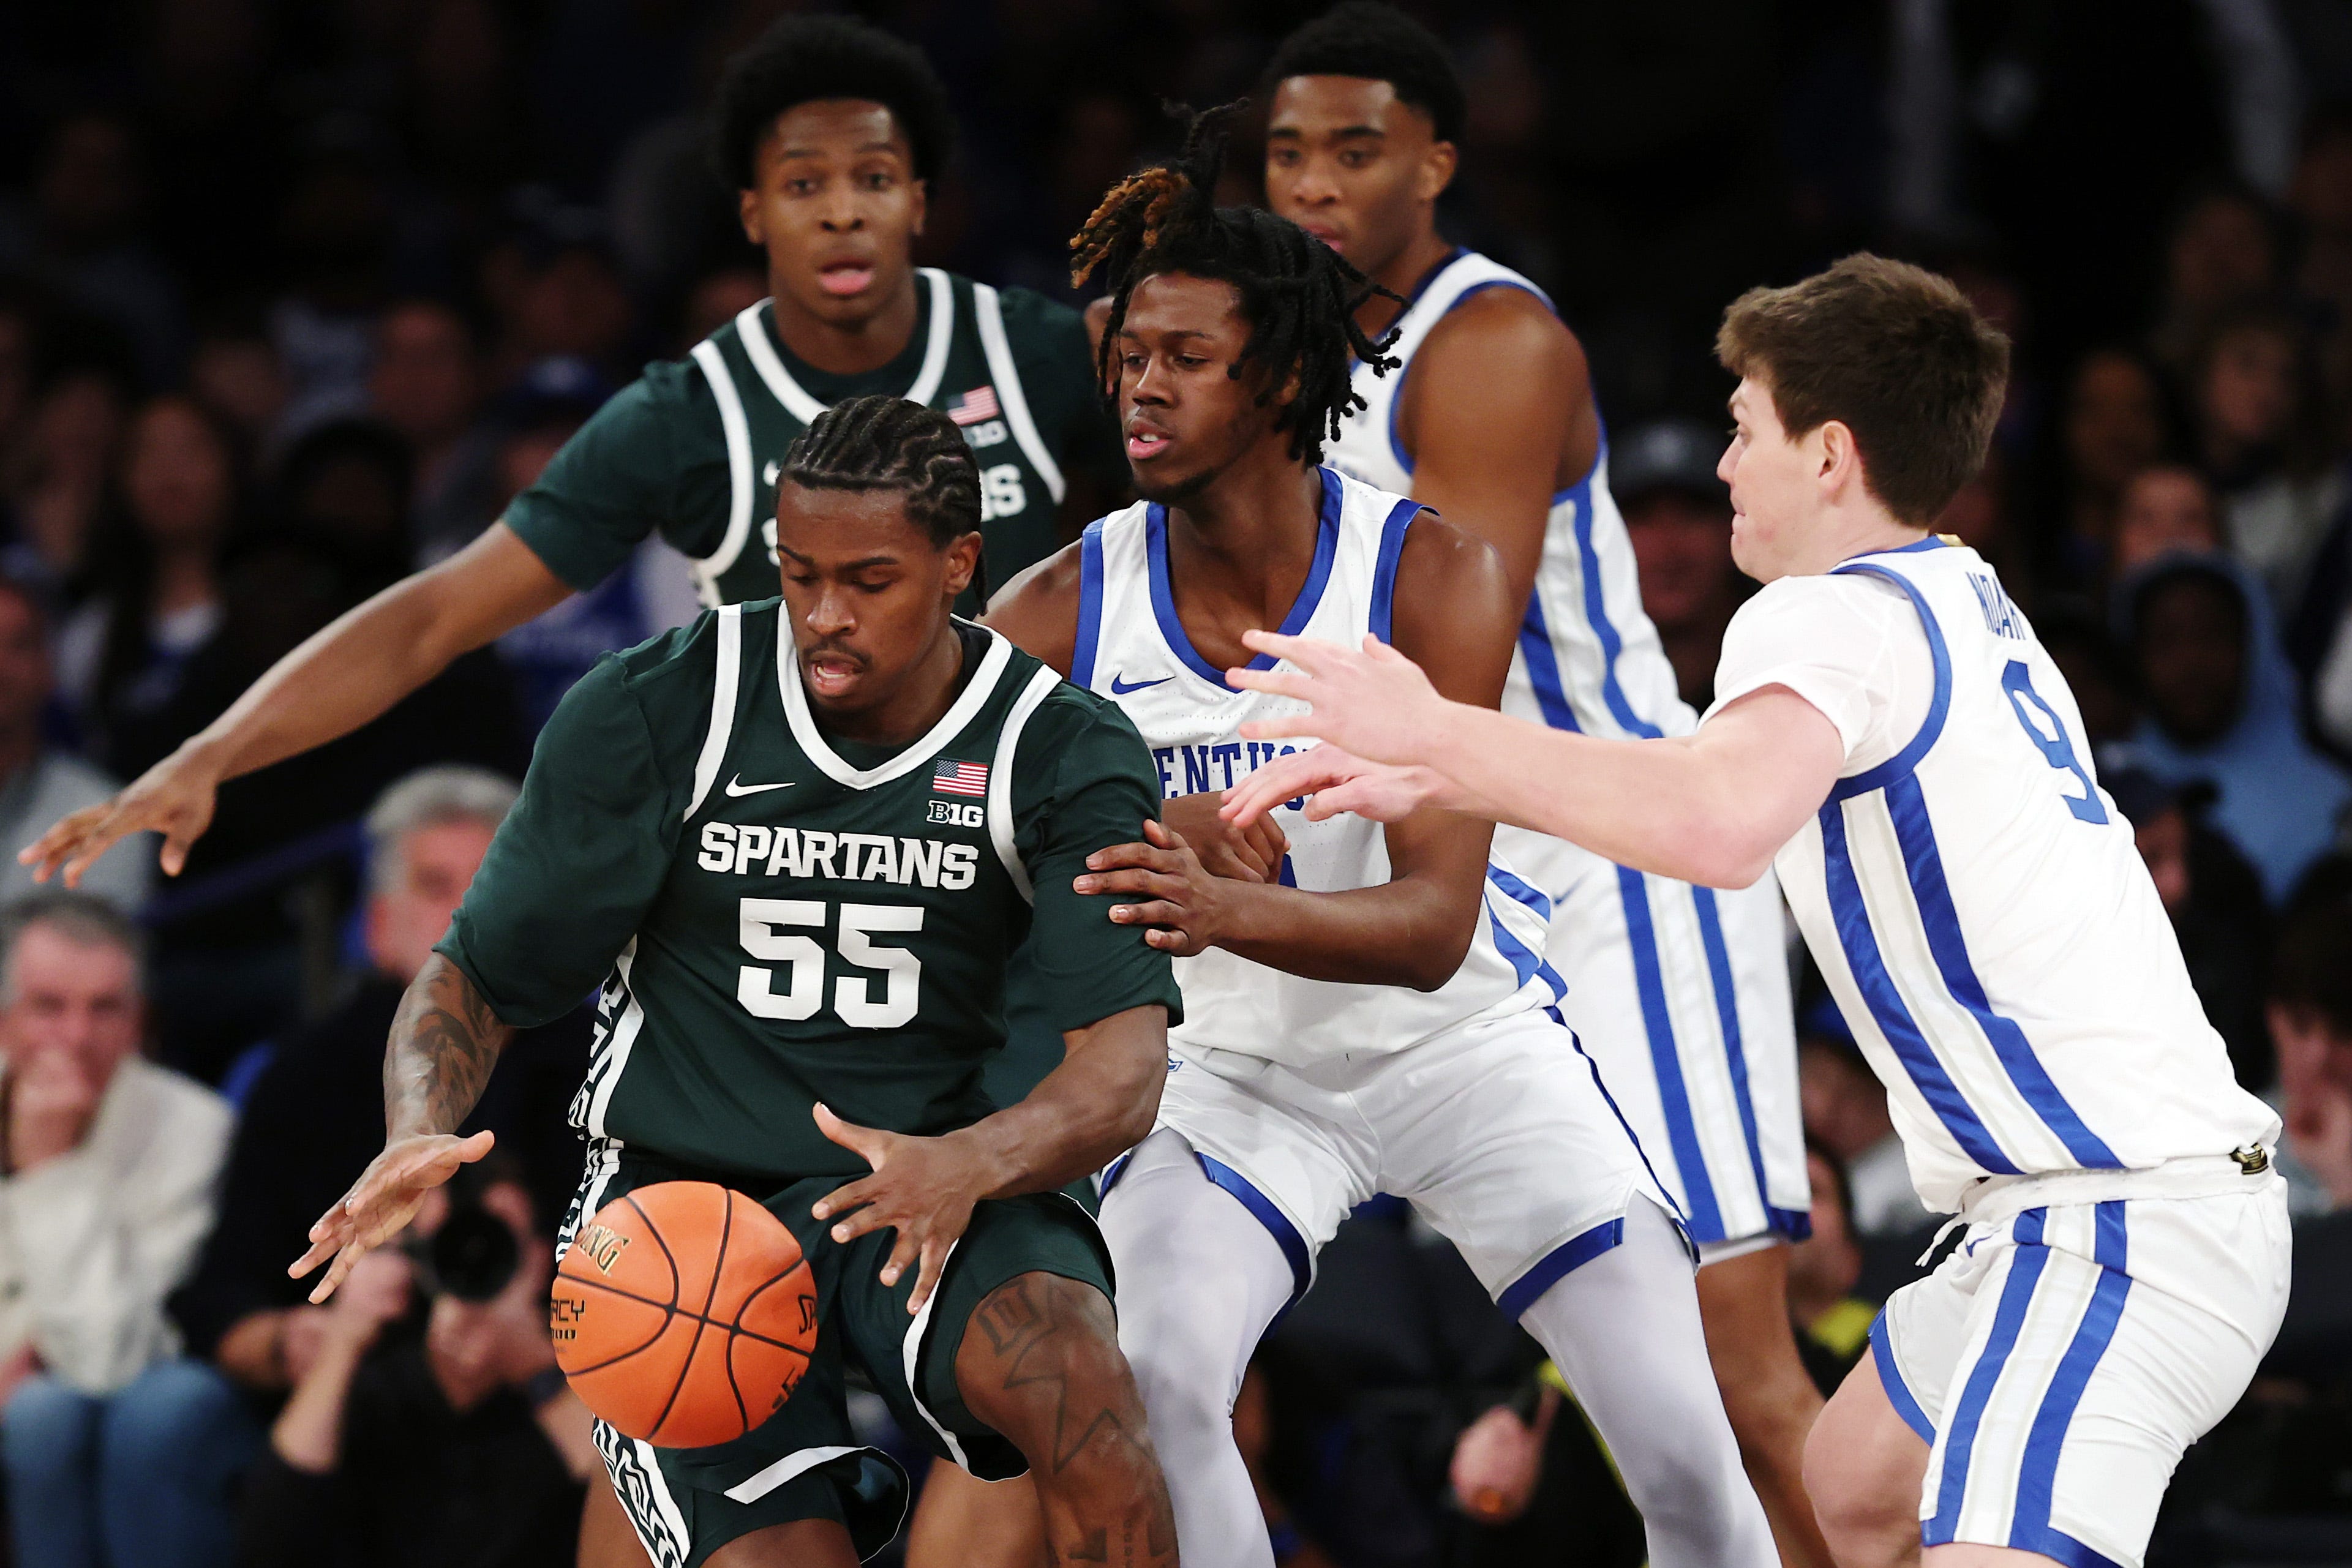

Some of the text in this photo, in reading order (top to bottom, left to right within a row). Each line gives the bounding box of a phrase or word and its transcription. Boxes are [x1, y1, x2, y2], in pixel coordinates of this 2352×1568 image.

[2002, 659, 2109, 825] 9
[697, 821, 979, 890] SPARTANS
[737, 898, 925, 1029] 55
